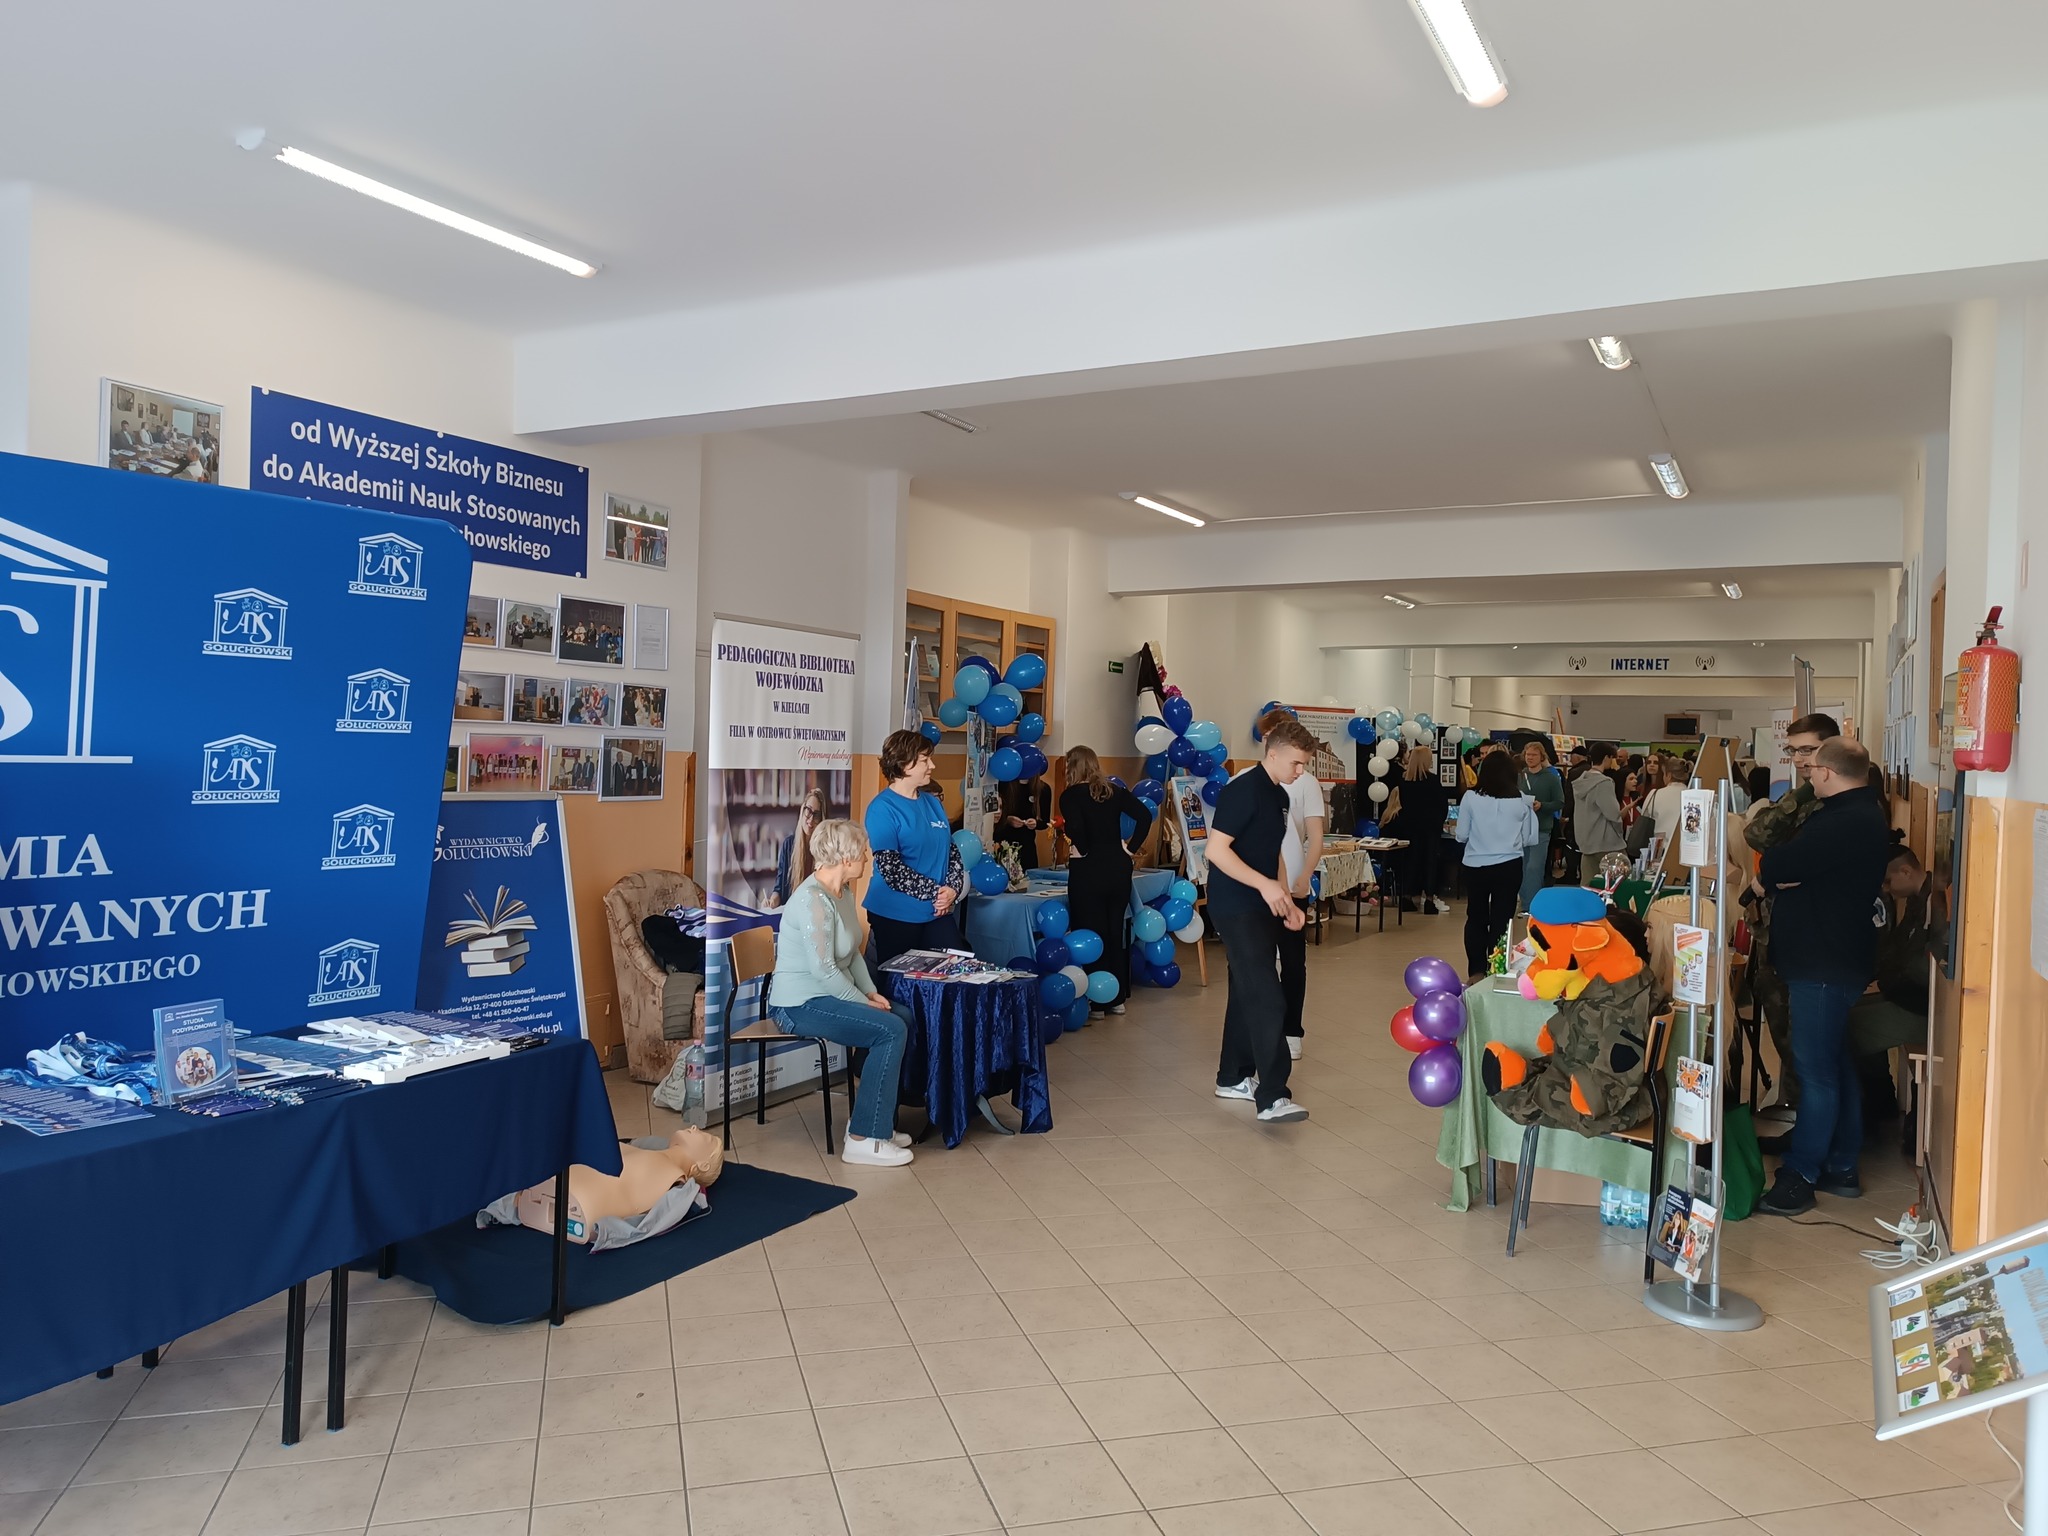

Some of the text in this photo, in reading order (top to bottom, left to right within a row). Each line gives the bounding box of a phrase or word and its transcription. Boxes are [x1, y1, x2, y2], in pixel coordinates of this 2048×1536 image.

[290, 419, 564, 497] od Wyższej Szkoły Biznesu
[262, 453, 294, 482] do
[298, 460, 404, 503] Akademii
[410, 482, 463, 514] Nauk
[466, 494, 581, 536] Stosowanych
[459, 525, 551, 561] howskiego
[348, 582, 428, 599] GOŁUCHOWSKI
[202, 642, 293, 657] GOŁUCHOWSKI
[717, 643, 856, 675] PEDAGOGICZNA BIBLIOTEKA
[1610, 658, 1670, 671] INTERNET
[755, 671, 824, 693] WOJEWÓDZKA
[773, 700, 810, 715] W KIELCACH
[336, 720, 412, 731] GOŁUCHOWSKI
[729, 724, 846, 742] FILIA W OSTROWCU ŚWIĘTOKRZYSKIM
[191, 791, 280, 801] GOŁUCHOWSKI
[449, 836, 523, 846] WYDAWNICTWO
[321, 855, 396, 868] GOŁUCHOWSKI
[0, 889, 271, 951] WANYCH
[0, 954, 201, 998] OWSKIEGO
[308, 986, 381, 1004] GOŁUCHOWSKI
[461, 992, 501, 1004] Wydawnictwo
[482, 1000, 503, 1010] 27-400
[503, 997, 530, 1007] Ostrowiec
[182, 1017, 205, 1026] STUDIA
[471, 1012, 481, 1020] tel.
[493, 1009, 500, 1017] 41
[171, 1020, 218, 1035] PODYPLOMOWE
